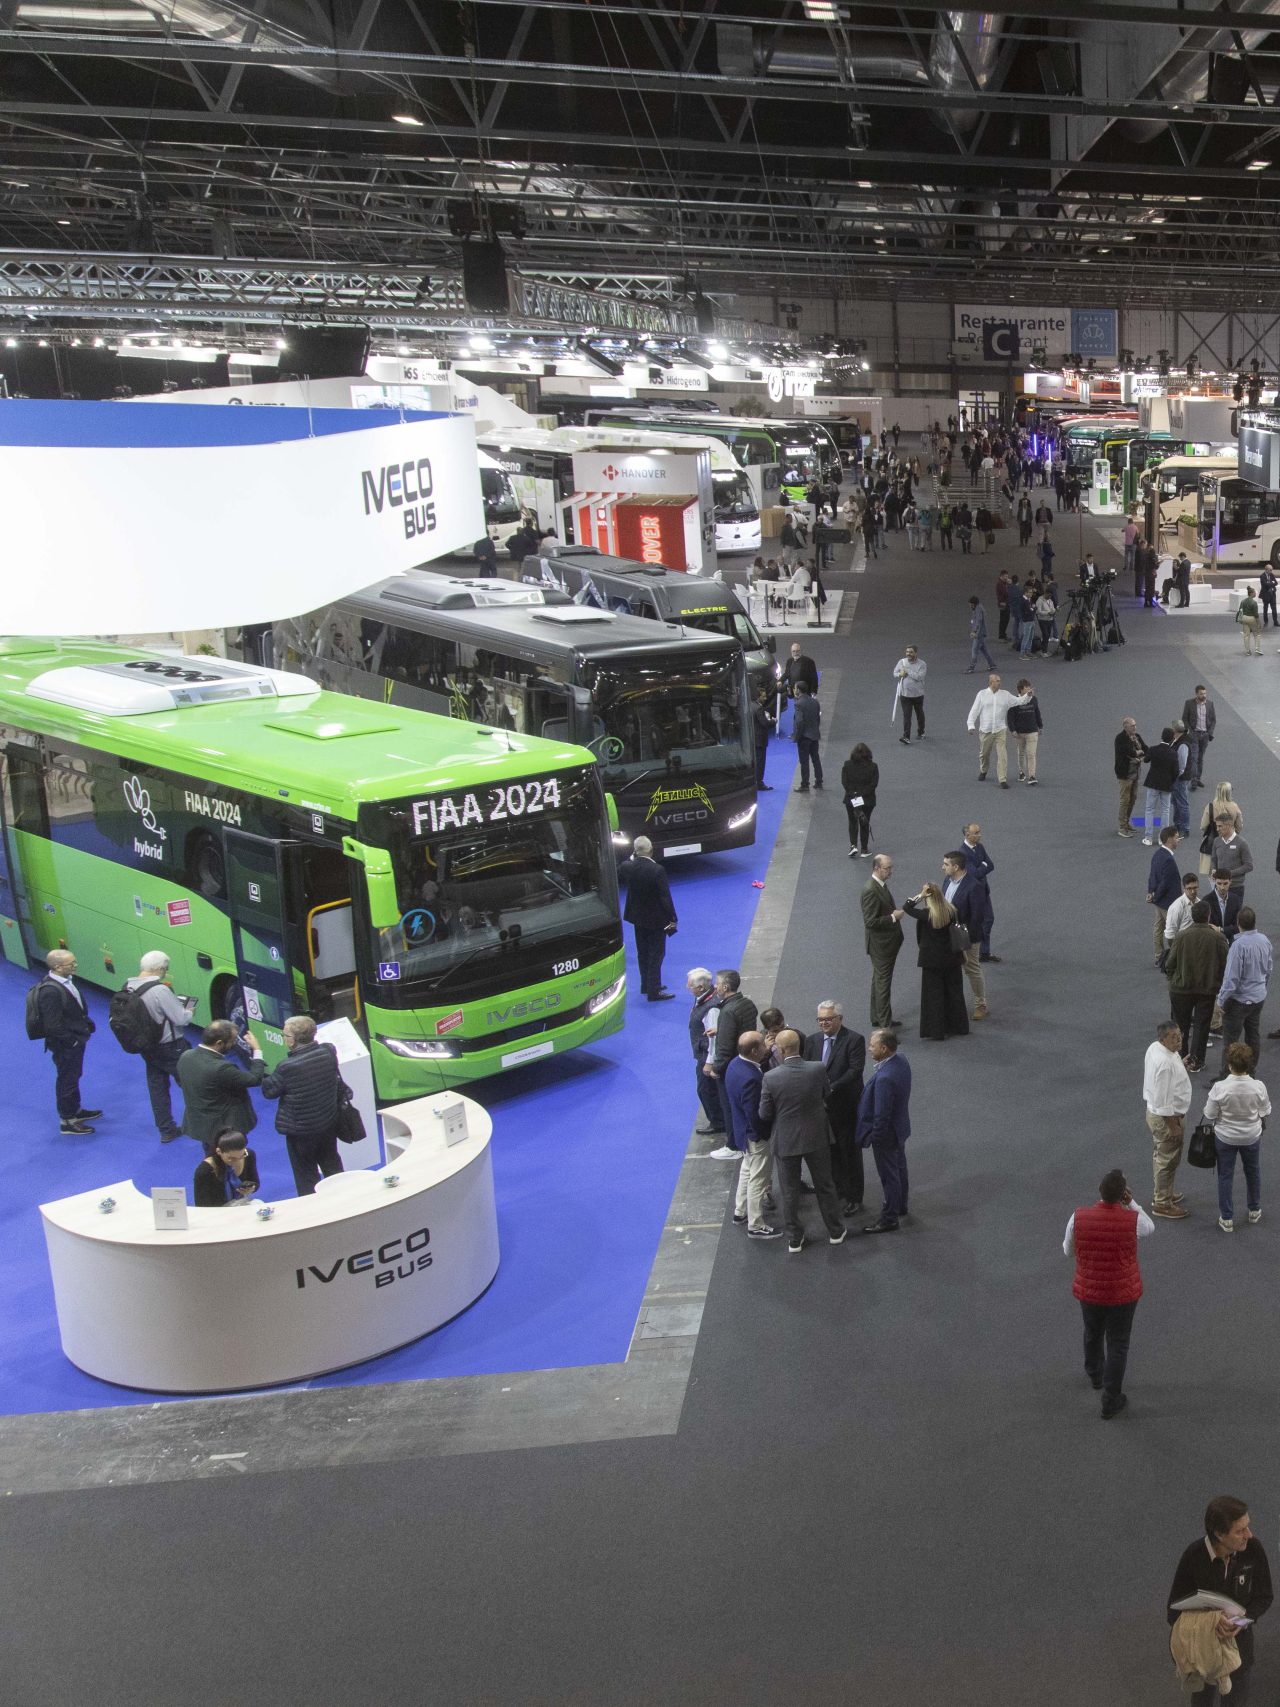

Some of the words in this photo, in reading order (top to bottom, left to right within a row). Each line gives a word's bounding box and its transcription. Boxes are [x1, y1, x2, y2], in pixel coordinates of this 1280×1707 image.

[968, 333, 1048, 348] Rerant
[991, 330, 1011, 357] C
[361, 457, 434, 516] IVECO
[621, 469, 667, 480] HANOVER
[403, 501, 437, 540] BUS
[642, 515, 661, 564] OVER
[680, 606, 729, 615] ELECTRIC
[185, 790, 211, 818] FIAA
[212, 798, 242, 827] 2024
[412, 793, 484, 835] FIAA
[487, 777, 562, 821] 2024
[654, 809, 708, 827] IVECO
[134, 837, 163, 861] hybrid
[551, 958, 580, 976] 1280
[486, 991, 561, 1026] IVECO
[263, 1029, 284, 1047] 1280
[296, 1227, 431, 1289] IVECO
[374, 1251, 434, 1289] BUS
